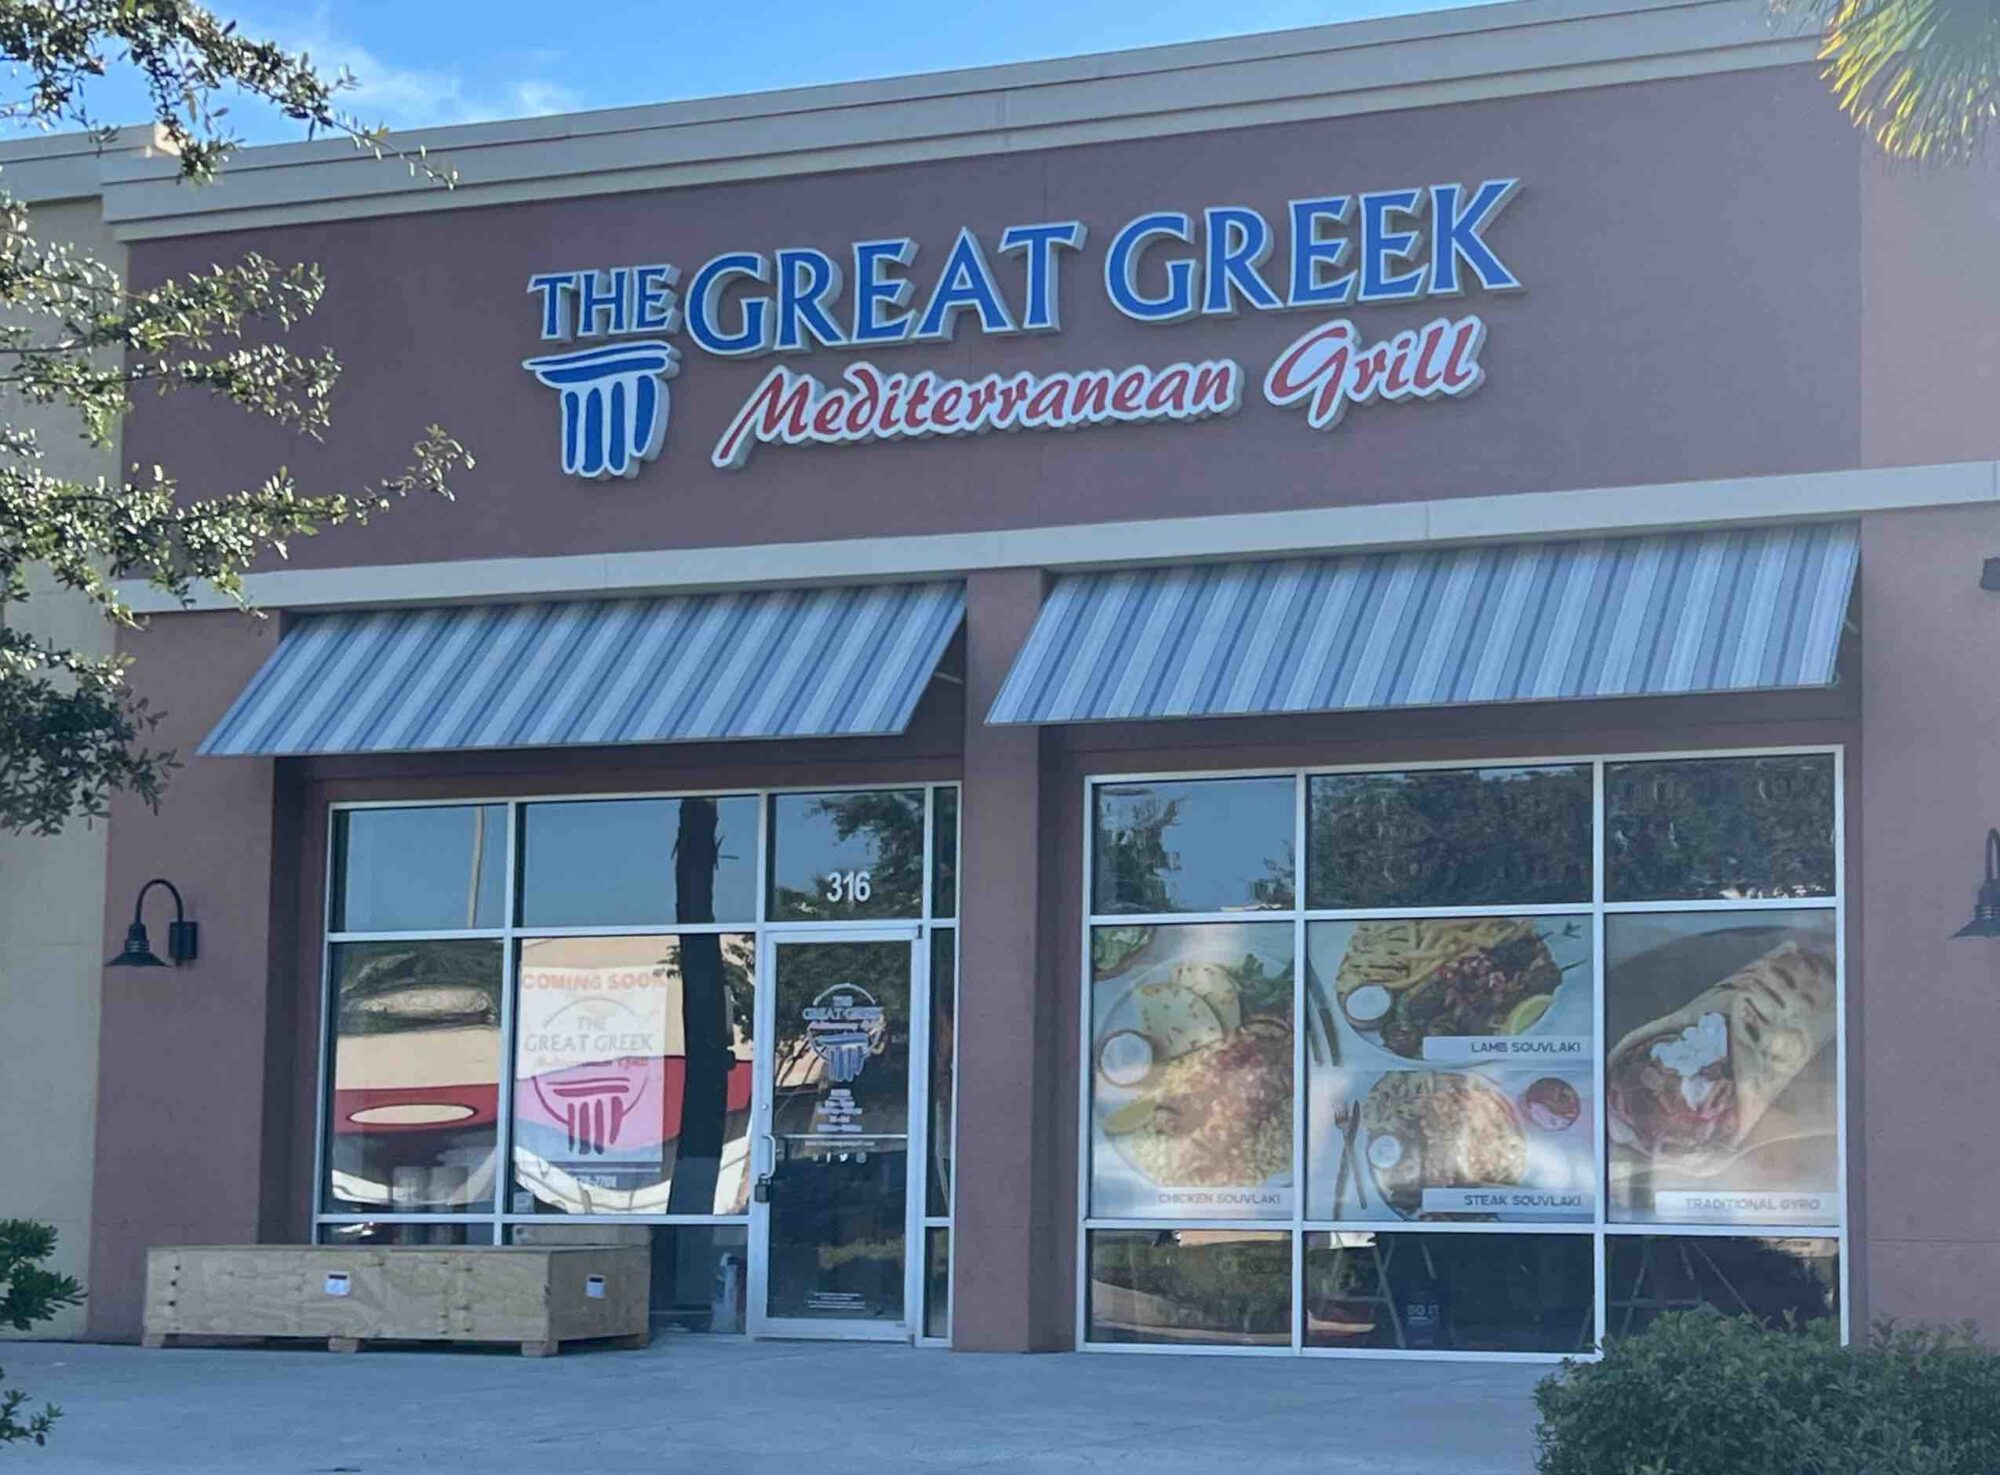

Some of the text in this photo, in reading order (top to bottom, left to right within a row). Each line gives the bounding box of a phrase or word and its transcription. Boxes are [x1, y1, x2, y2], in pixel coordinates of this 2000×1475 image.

[526, 177, 1524, 357] THE GREAT GREEK
[710, 315, 1487, 469] Mediterranean Grill
[826, 871, 871, 902] 316
[523, 972, 601, 992] COMING
[577, 1016, 607, 1031] THE
[524, 1033, 653, 1052] GREAT GREEK
[1471, 1041, 1582, 1053] LAMB SOUVLAKI
[1159, 1192, 1281, 1205] CHICKEN SOUVLAKI
[1464, 1195, 1582, 1207] STEAK SOUVLAKI
[1686, 1198, 1821, 1211] TRADITIONAL GYRO
